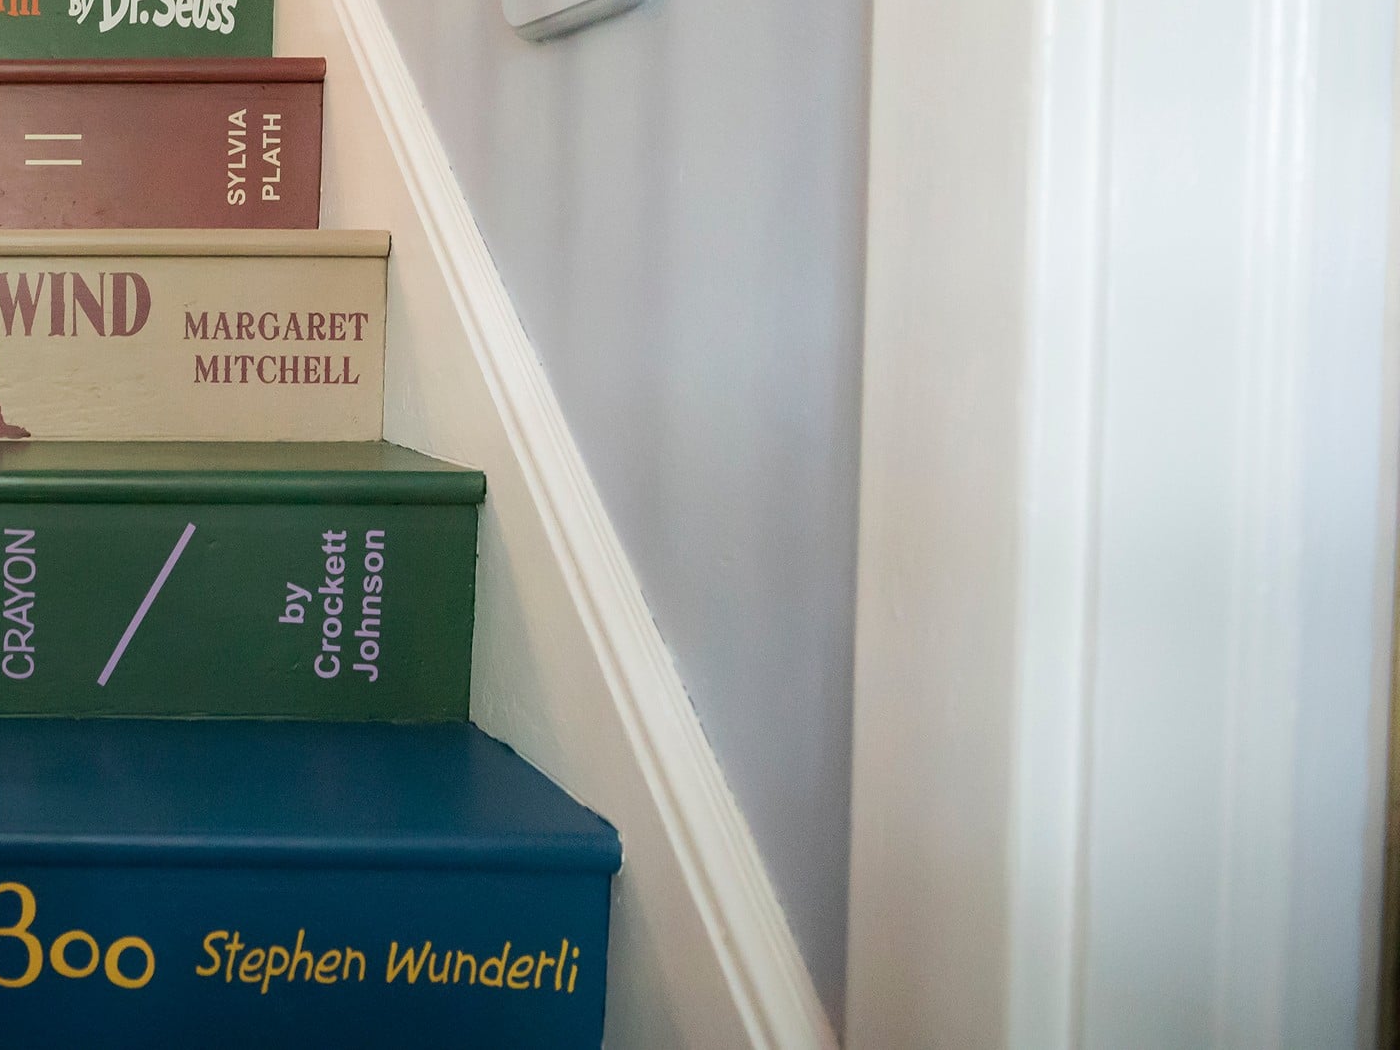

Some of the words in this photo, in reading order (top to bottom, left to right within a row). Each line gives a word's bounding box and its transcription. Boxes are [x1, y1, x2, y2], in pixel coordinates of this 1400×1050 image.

[227, 109, 246, 205] SYLVIA
[262, 114, 281, 200] PLATH
[184, 312, 368, 341] MARGARET
[194, 355, 360, 384] MITCHELL
[2, 529, 36, 678] CRAYON
[279, 582, 313, 624] by
[314, 530, 347, 679] Crockett
[353, 530, 385, 682] Johnson
[196, 929, 365, 993] Stephen
[387, 939, 579, 992] Wunderli
